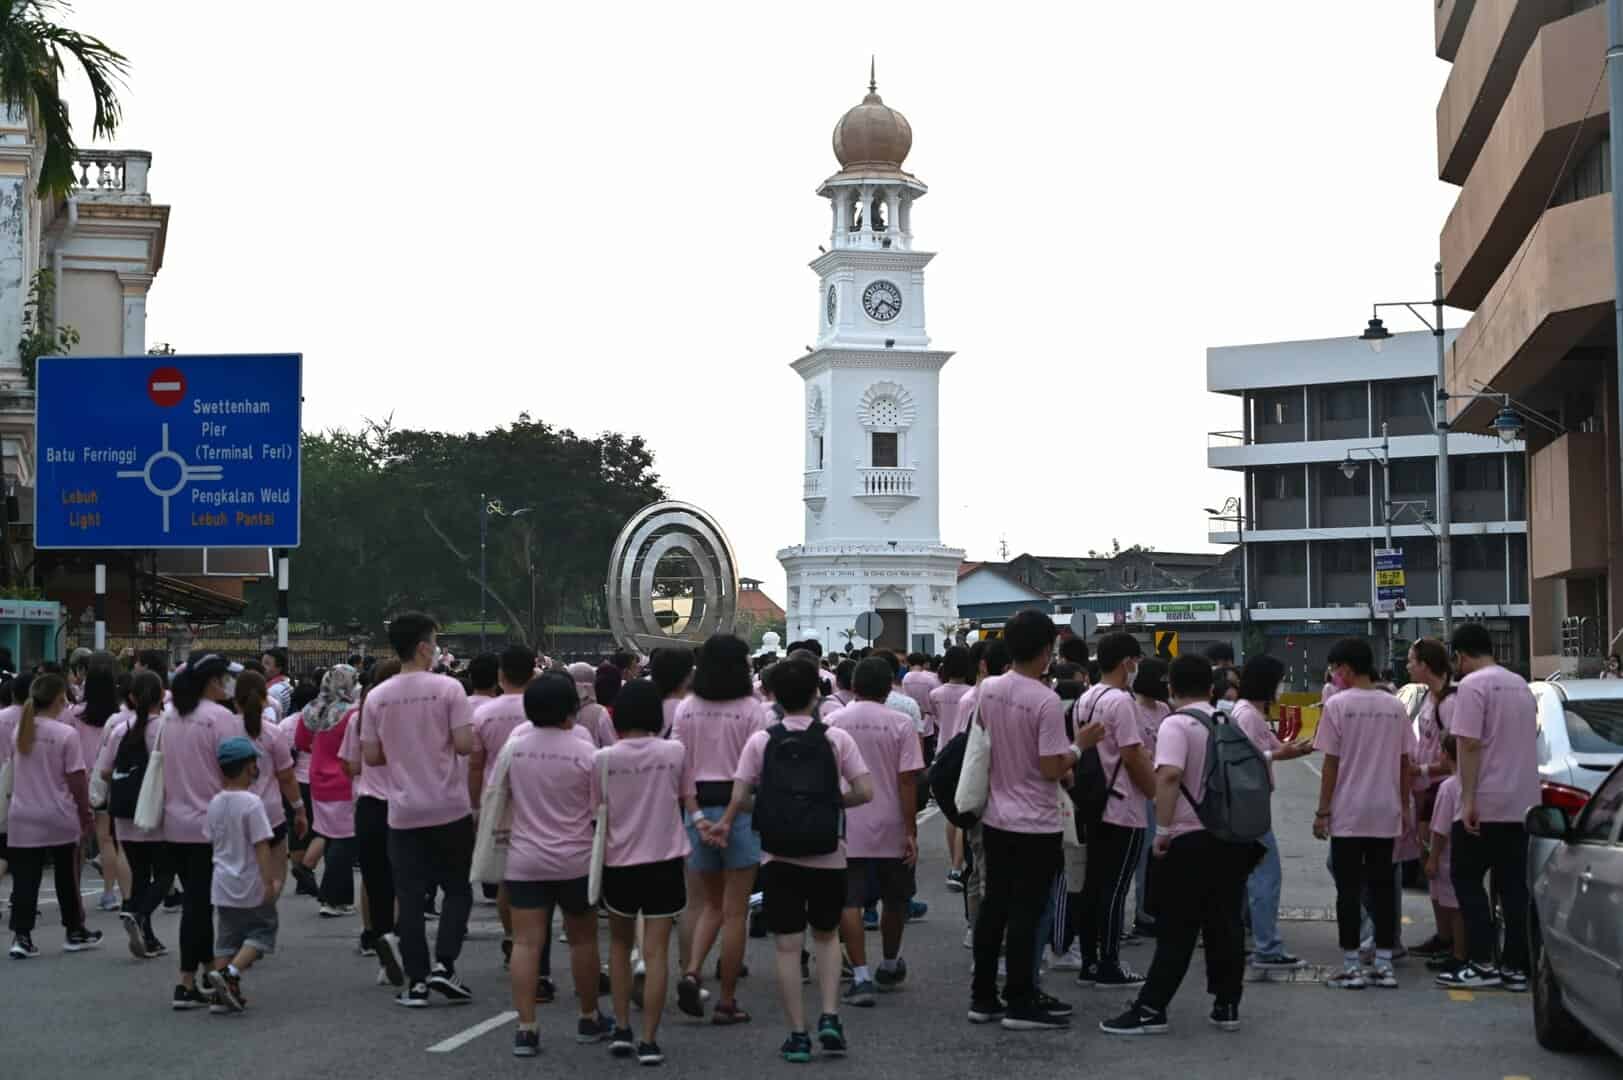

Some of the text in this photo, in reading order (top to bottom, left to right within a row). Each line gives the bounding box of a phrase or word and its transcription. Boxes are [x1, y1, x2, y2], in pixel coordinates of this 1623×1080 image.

[193, 399, 270, 414] Swettenham
[202, 421, 227, 437] Pier
[47, 446, 137, 464] Batu Ferringgi
[195, 443, 292, 460] (Terminal Feri)
[62, 488, 98, 504] Lebuh
[192, 487, 290, 506] Pengkalan Weld
[69, 512, 101, 528] Light
[191, 512, 275, 527] Lebuh Pantai
